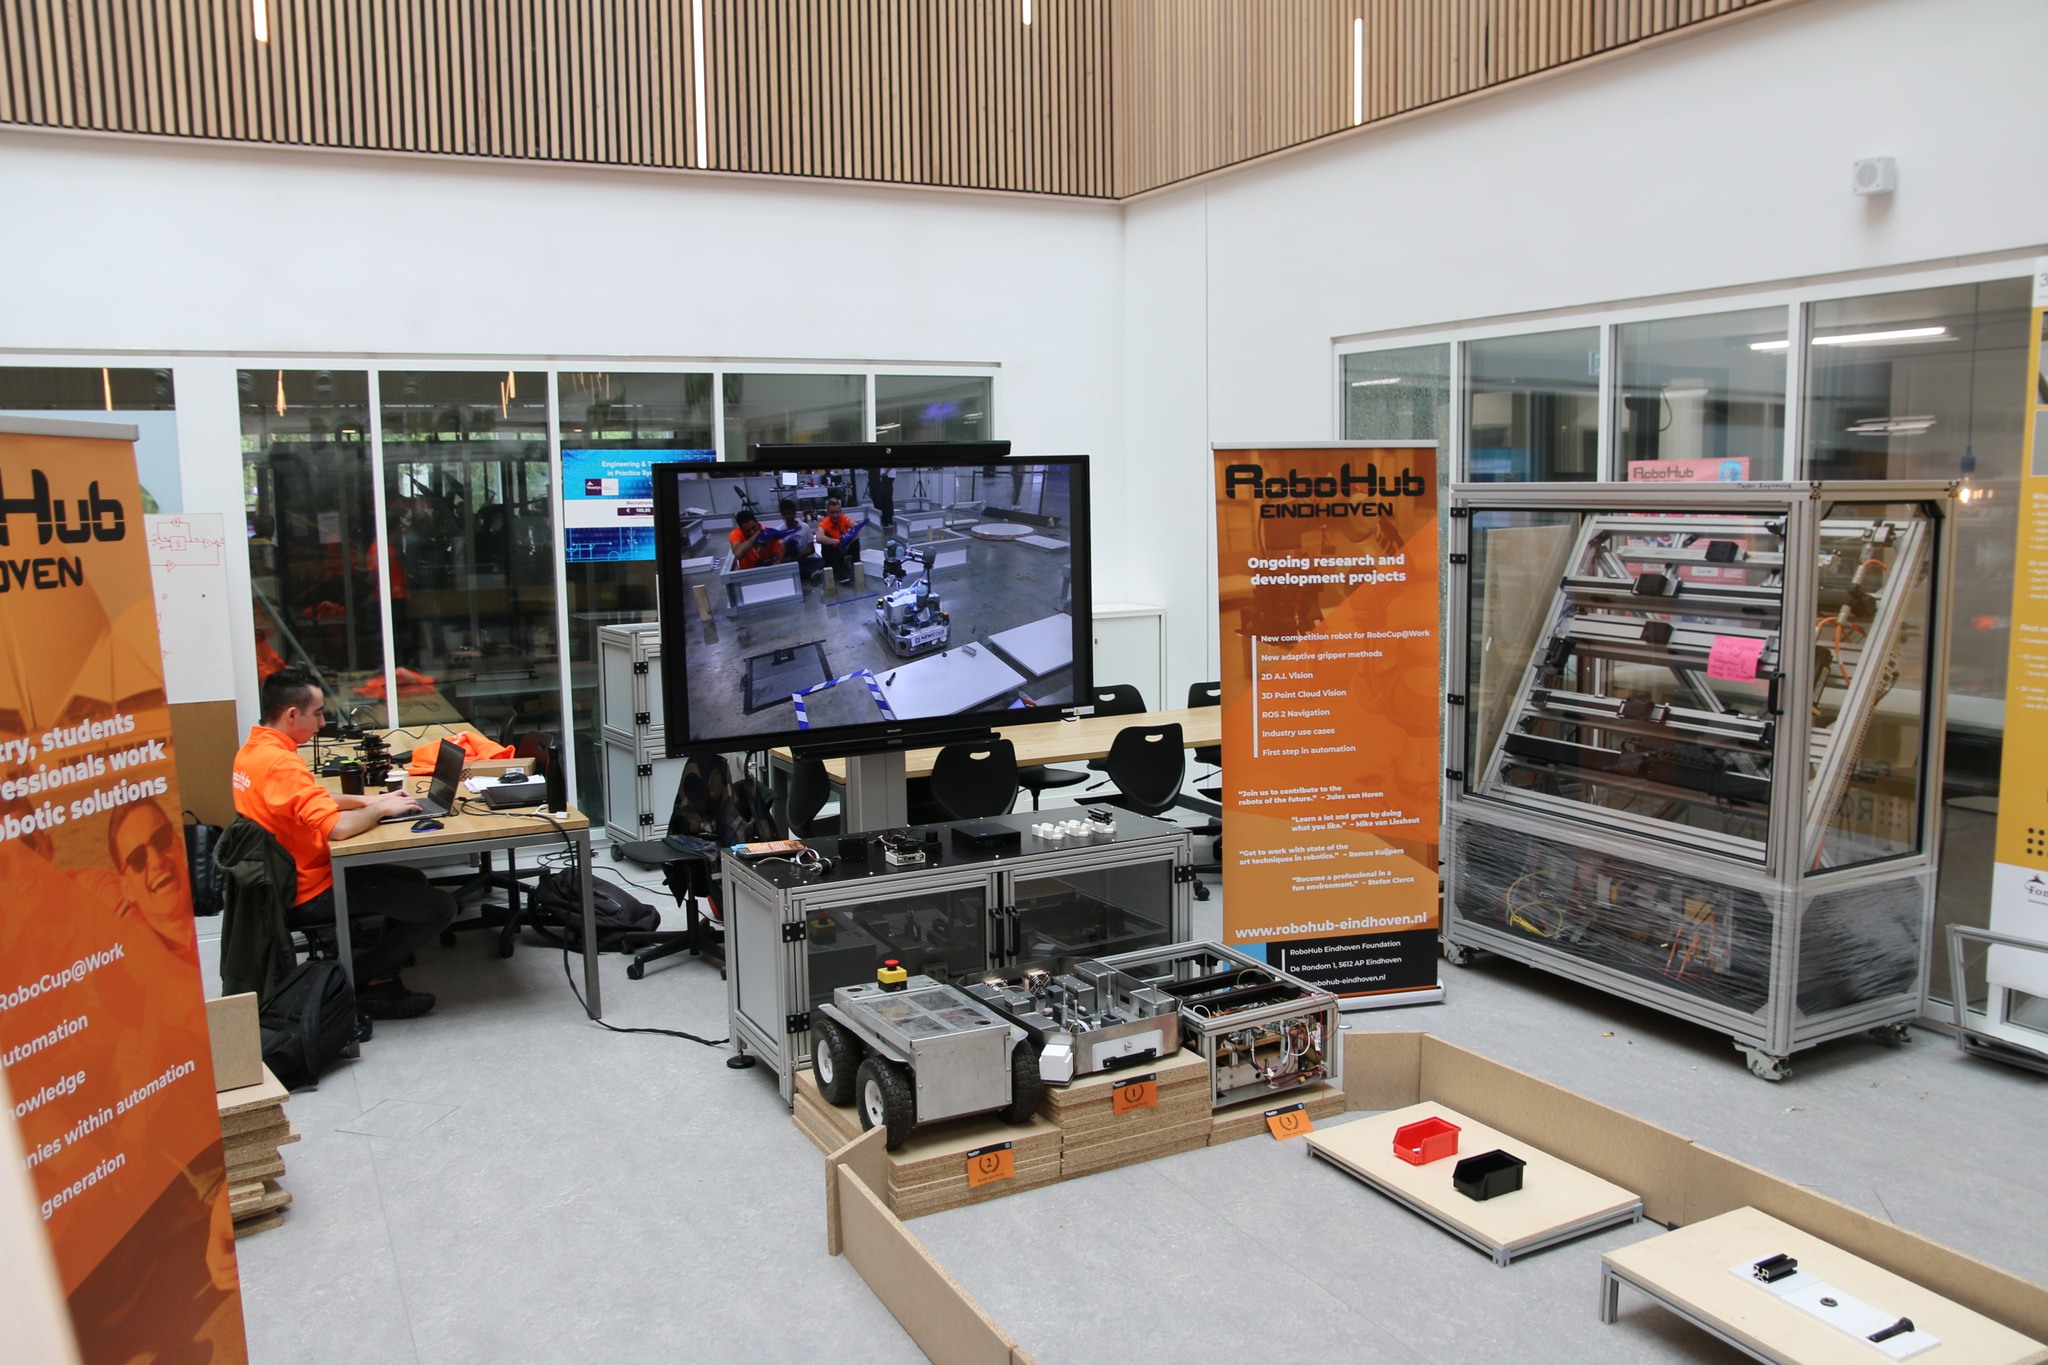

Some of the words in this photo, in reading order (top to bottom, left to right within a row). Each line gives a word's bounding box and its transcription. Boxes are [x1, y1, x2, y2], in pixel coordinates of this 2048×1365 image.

[1633, 466, 1694, 479] RoboHub
[1226, 463, 1425, 499] RoboHub
[1260, 502, 1393, 518] EINDHOVEN
[1248, 556, 1310, 570] Ongoing
[1314, 554, 1374, 566] research
[1378, 554, 1405, 566] and
[1250, 572, 1346, 586] development
[1349, 570, 1406, 585] projects
[1281, 633, 1329, 642] competition
[1331, 632, 1352, 640] robot
[1366, 630, 1430, 639] RoboCup@Work
[1261, 654, 1280, 662] New
[1281, 652, 1316, 661] adaptive
[1318, 651, 1347, 660] gripper
[1348, 650, 1382, 658] methods
[1274, 672, 1288, 680] A.I.
[1262, 692, 1272, 700] 3D
[1298, 690, 1320, 698] Cloud
[1288, 709, 1330, 718] Navigation
[42, 714, 135, 752] students
[1262, 730, 1296, 738] Industry
[1282, 748, 1300, 756] step
[1310, 745, 1356, 754] automation
[0, 754, 105, 800] essionals
[109, 740, 167, 771] work
[70, 776, 168, 820] solutions
[1280, 787, 1318, 795] contribute
[1239, 798, 1263, 806] robots
[1382, 810, 1402, 818] doing
[1292, 824, 1311, 832] what
[1312, 824, 1326, 832] you
[1356, 820, 1374, 828] Mike
[1390, 817, 1420, 825] Lieshout
[1288, 846, 1306, 854] with
[1240, 858, 1250, 866] art
[1252, 856, 1293, 865] techniques
[1348, 850, 1374, 858] Remco
[1333, 870, 1377, 881] professional
[1292, 884, 1305, 892] fun
[1367, 878, 1392, 886] Stefan
[1235, 912, 1427, 938] www.robohub-eindhoven.nl
[1290, 946, 1323, 956] RoboHub
[1324, 944, 1360, 953] Eindhoven
[1362, 940, 1401, 950] Foundation
[1302, 964, 1331, 972] Rondom
[1332, 962, 1338, 970] 1,
[1366, 956, 1402, 966] Eindhoven
[1307, 974, 1386, 987] robohub-eindhoven.nl
[0, 1013, 88, 1069] utomation
[64, 1108, 114, 1147] within
[116, 1058, 196, 1115] automation
[41, 1151, 126, 1220] generation
